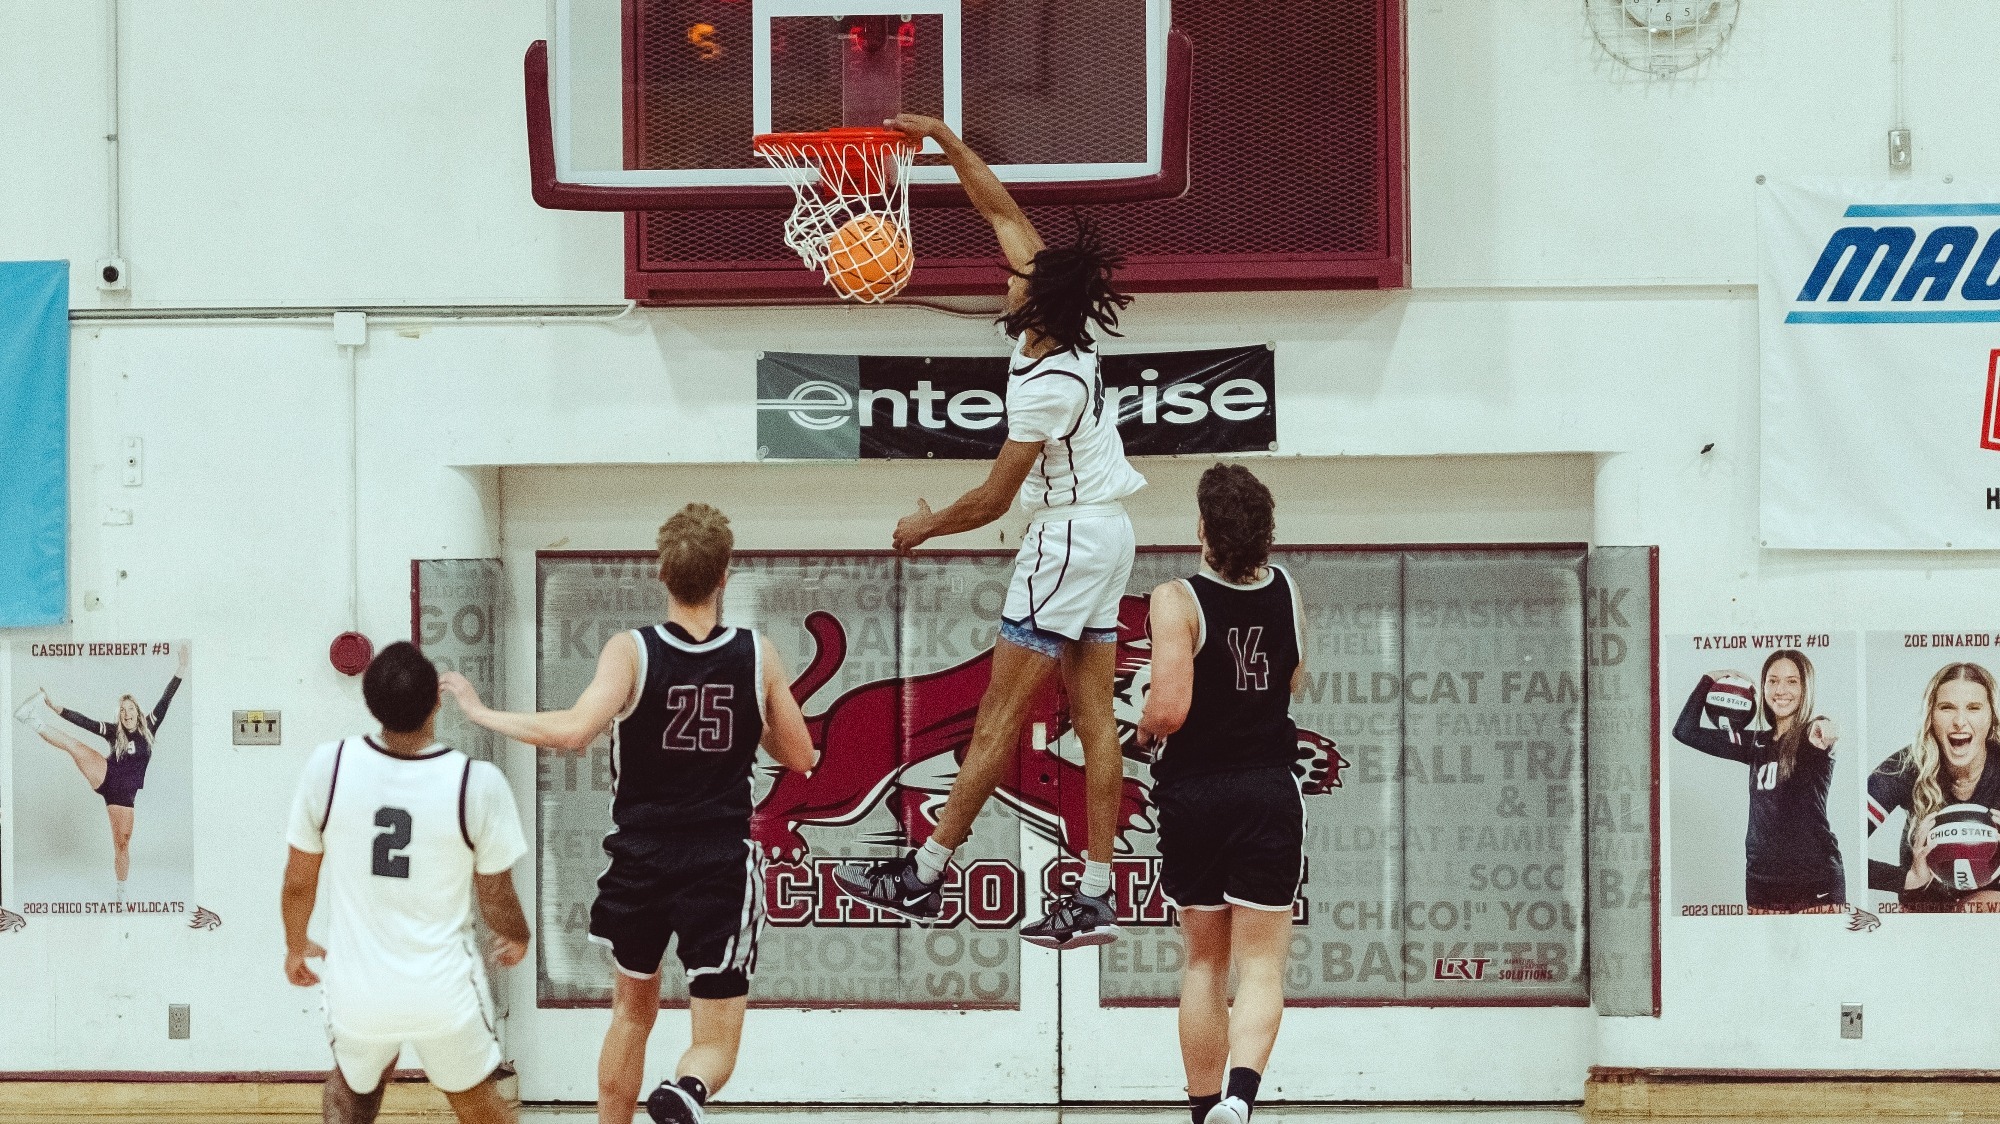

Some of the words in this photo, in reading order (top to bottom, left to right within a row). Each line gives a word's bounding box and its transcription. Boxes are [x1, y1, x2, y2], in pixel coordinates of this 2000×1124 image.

[757, 366, 1268, 430] enterise
[1693, 635, 1747, 649] TAYLOR
[1751, 634, 1803, 648] WHYTE
[1806, 633, 1830, 648] #10
[1903, 634, 1928, 648] ZOE
[1931, 633, 1990, 648] DINARDO
[31, 643, 84, 657] CASSIDY
[89, 642, 148, 656] HERBERT
[152, 642, 171, 656] #9
[1226, 625, 1270, 691] 14
[1295, 671, 1485, 705] WILDCAT
[661, 683, 735, 752] 25
[1930, 828, 1958, 840] CHICO
[1961, 827, 1993, 838] STATE
[371, 806, 413, 879] 2
[23, 902, 49, 914] 2023
[51, 902, 82, 914] CHICO
[85, 901, 123, 914] STATE
[126, 901, 185, 913] WILDCATS
[1681, 904, 1708, 917] 2023
[1711, 904, 1744, 917] CHICO
[1499, 969, 1554, 981] SOLUTIONS
